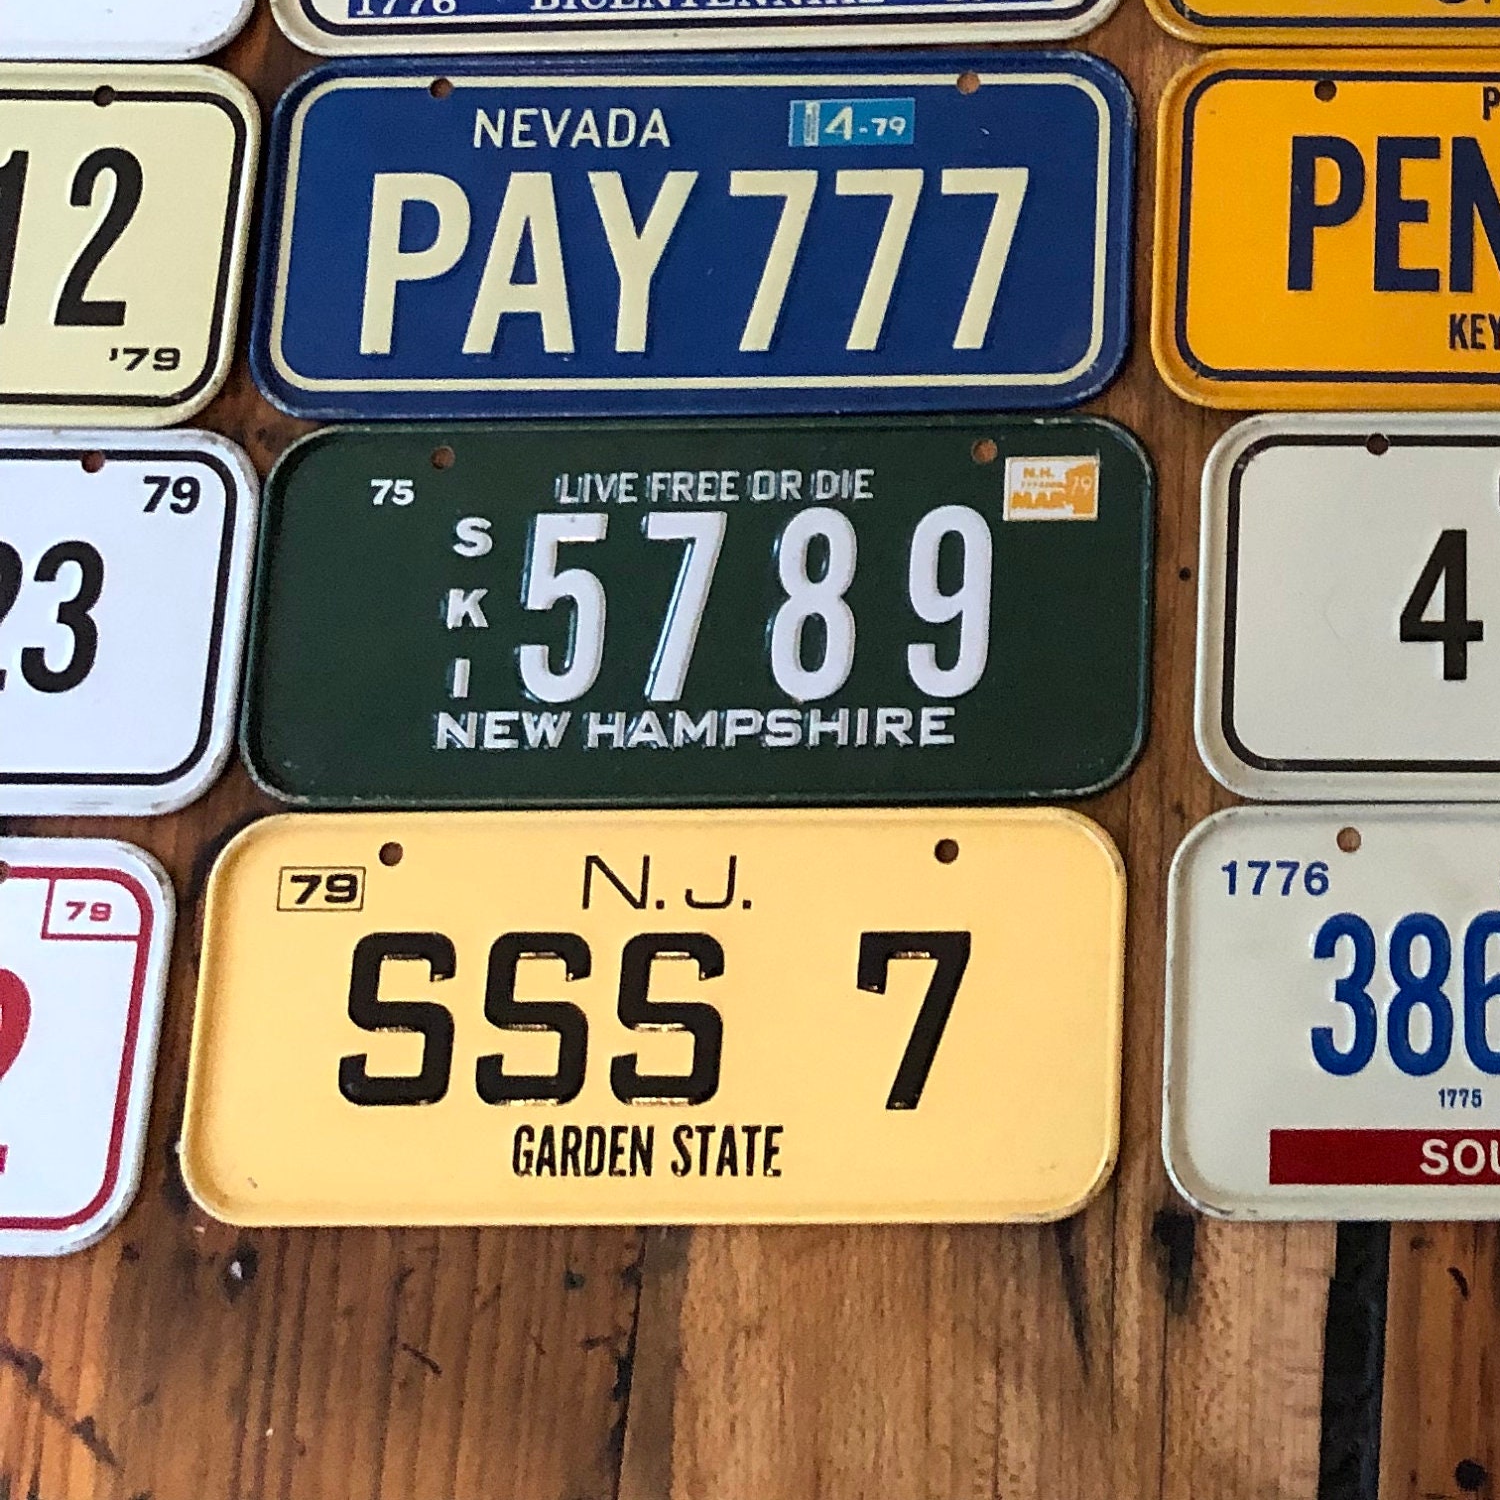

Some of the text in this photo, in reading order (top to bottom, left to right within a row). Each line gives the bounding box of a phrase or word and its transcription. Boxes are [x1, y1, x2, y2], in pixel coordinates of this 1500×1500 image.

[474, 108, 670, 149] NEVADA
[359, 167, 1029, 355] PAY 777
[143, 476, 201, 514] 79
[371, 480, 414, 505] 75
[556, 469, 875, 504] LIVE FREE OR DIE
[435, 707, 956, 750] NEW HAMPSHIRE
[289, 874, 358, 903] 79
[1221, 860, 1330, 896] 1776
[66, 900, 112, 921] 79
[338, 931, 971, 1110] SSS 7
[1438, 1089, 1482, 1108] 1775
[513, 1125, 784, 1177] GARDEN STATE
